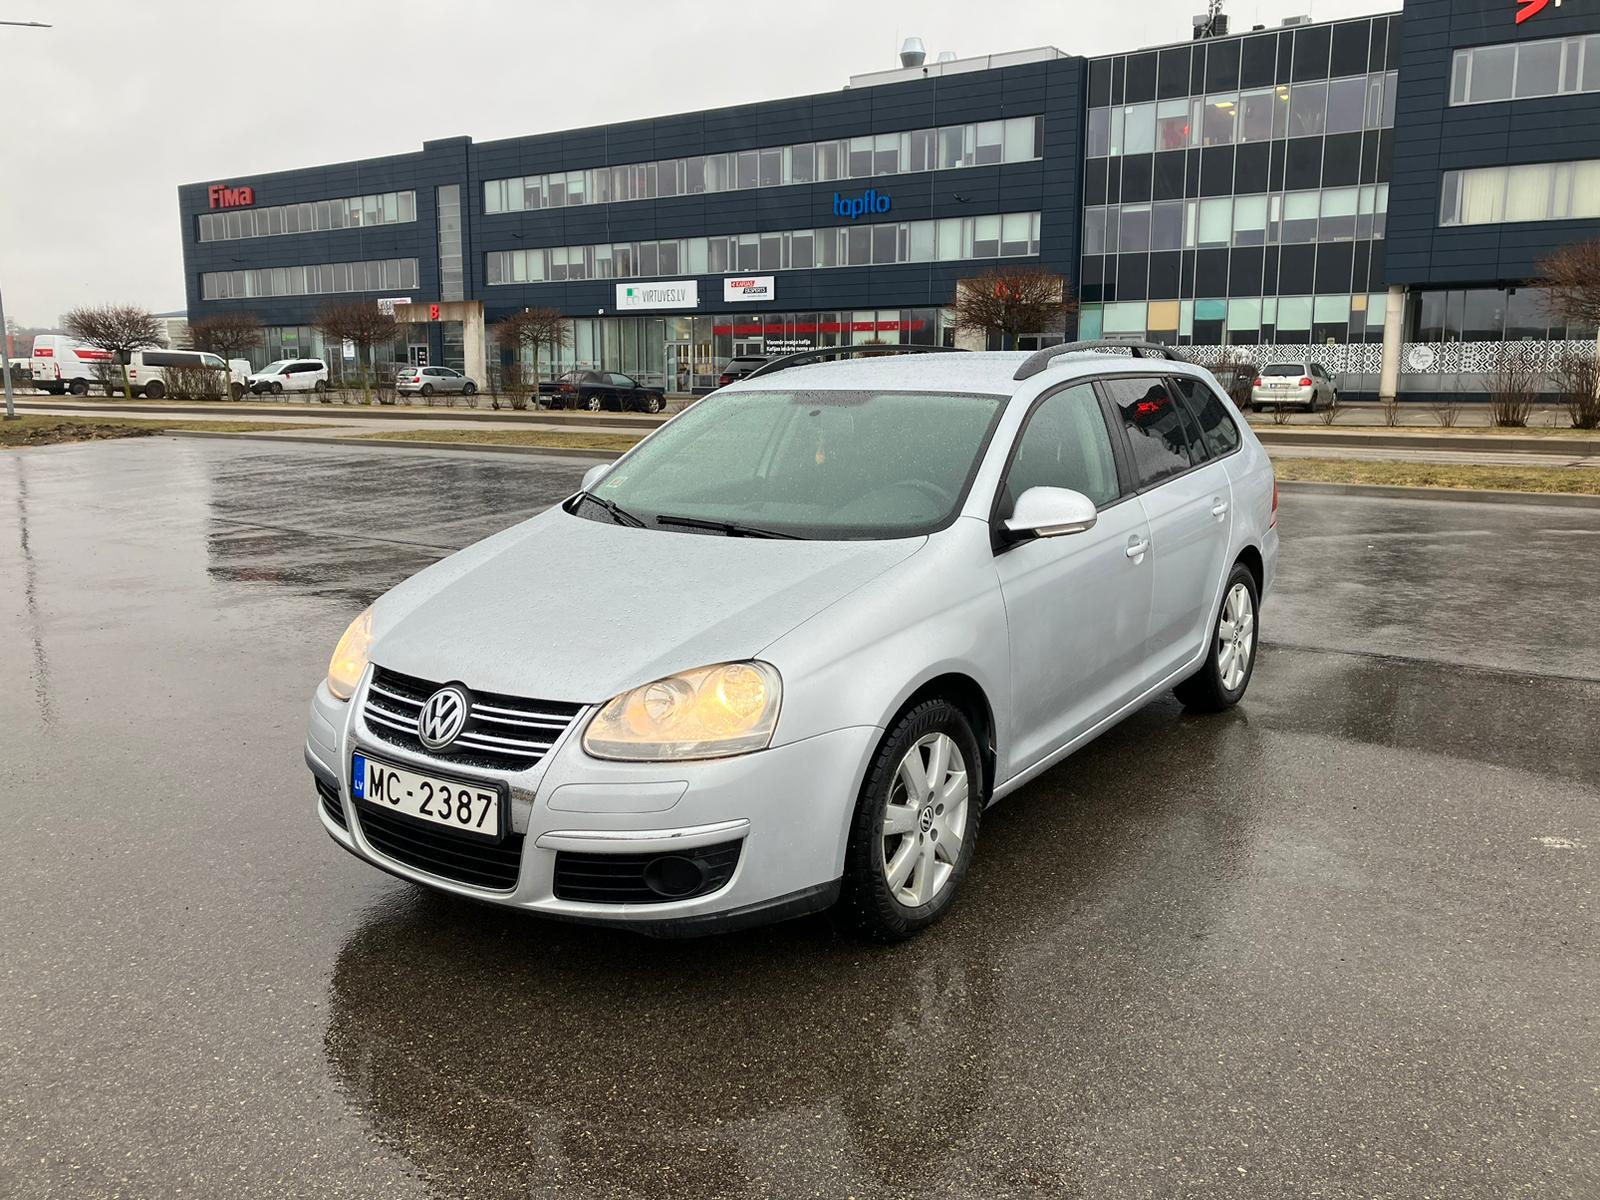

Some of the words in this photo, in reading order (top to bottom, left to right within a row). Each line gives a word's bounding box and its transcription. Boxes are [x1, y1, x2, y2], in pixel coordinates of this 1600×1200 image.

[642, 288, 686, 303] VIRTUVES.LV
[429, 304, 439, 320] B
[354, 779, 364, 790] LV
[369, 765, 492, 828] MC-2387
